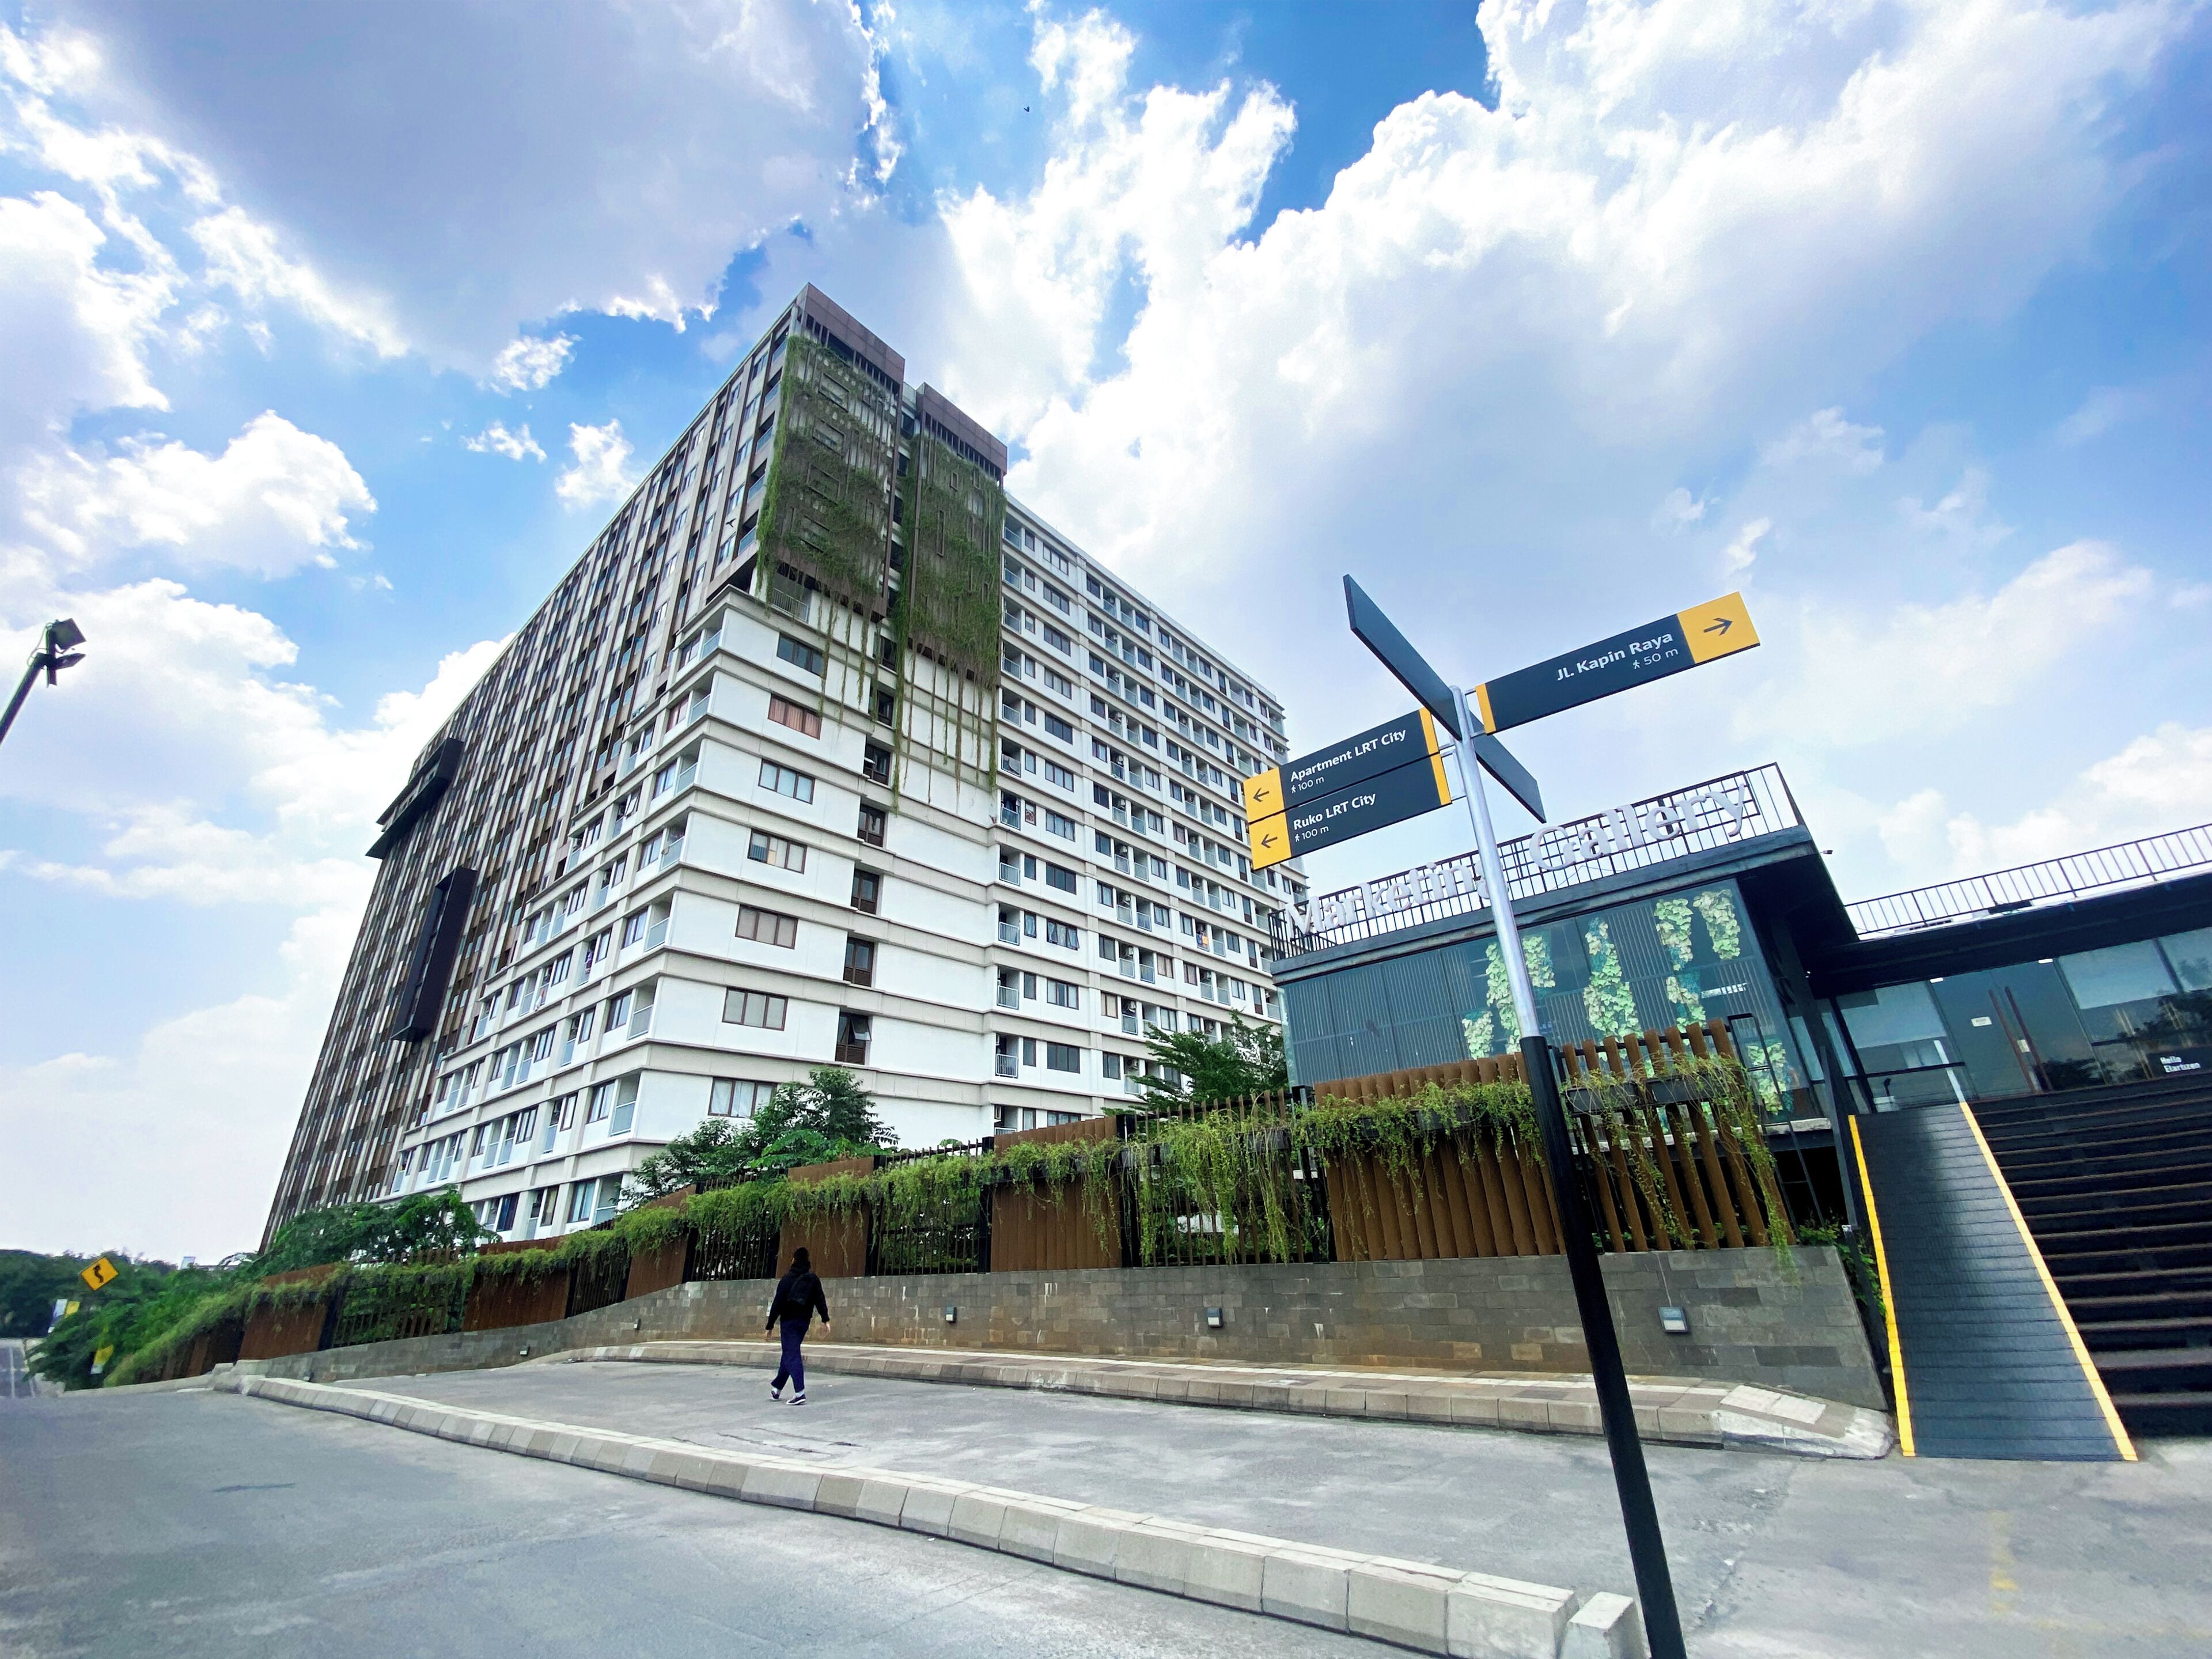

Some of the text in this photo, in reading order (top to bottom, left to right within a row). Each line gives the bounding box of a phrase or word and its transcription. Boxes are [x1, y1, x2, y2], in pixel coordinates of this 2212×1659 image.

[1576, 650, 1626, 673] Kapin
[1628, 633, 1673, 655] Raya
[1644, 647, 1679, 666] 50 m
[1290, 729, 1407, 782] Apartment LRT City
[1298, 776, 1324, 791] 100 m
[1293, 793, 1376, 830] Ruko LRT City
[1302, 825, 1329, 840] 100 m
[1529, 783, 1745, 871] Gallery
[2160, 1055, 2181, 1065] Hello
